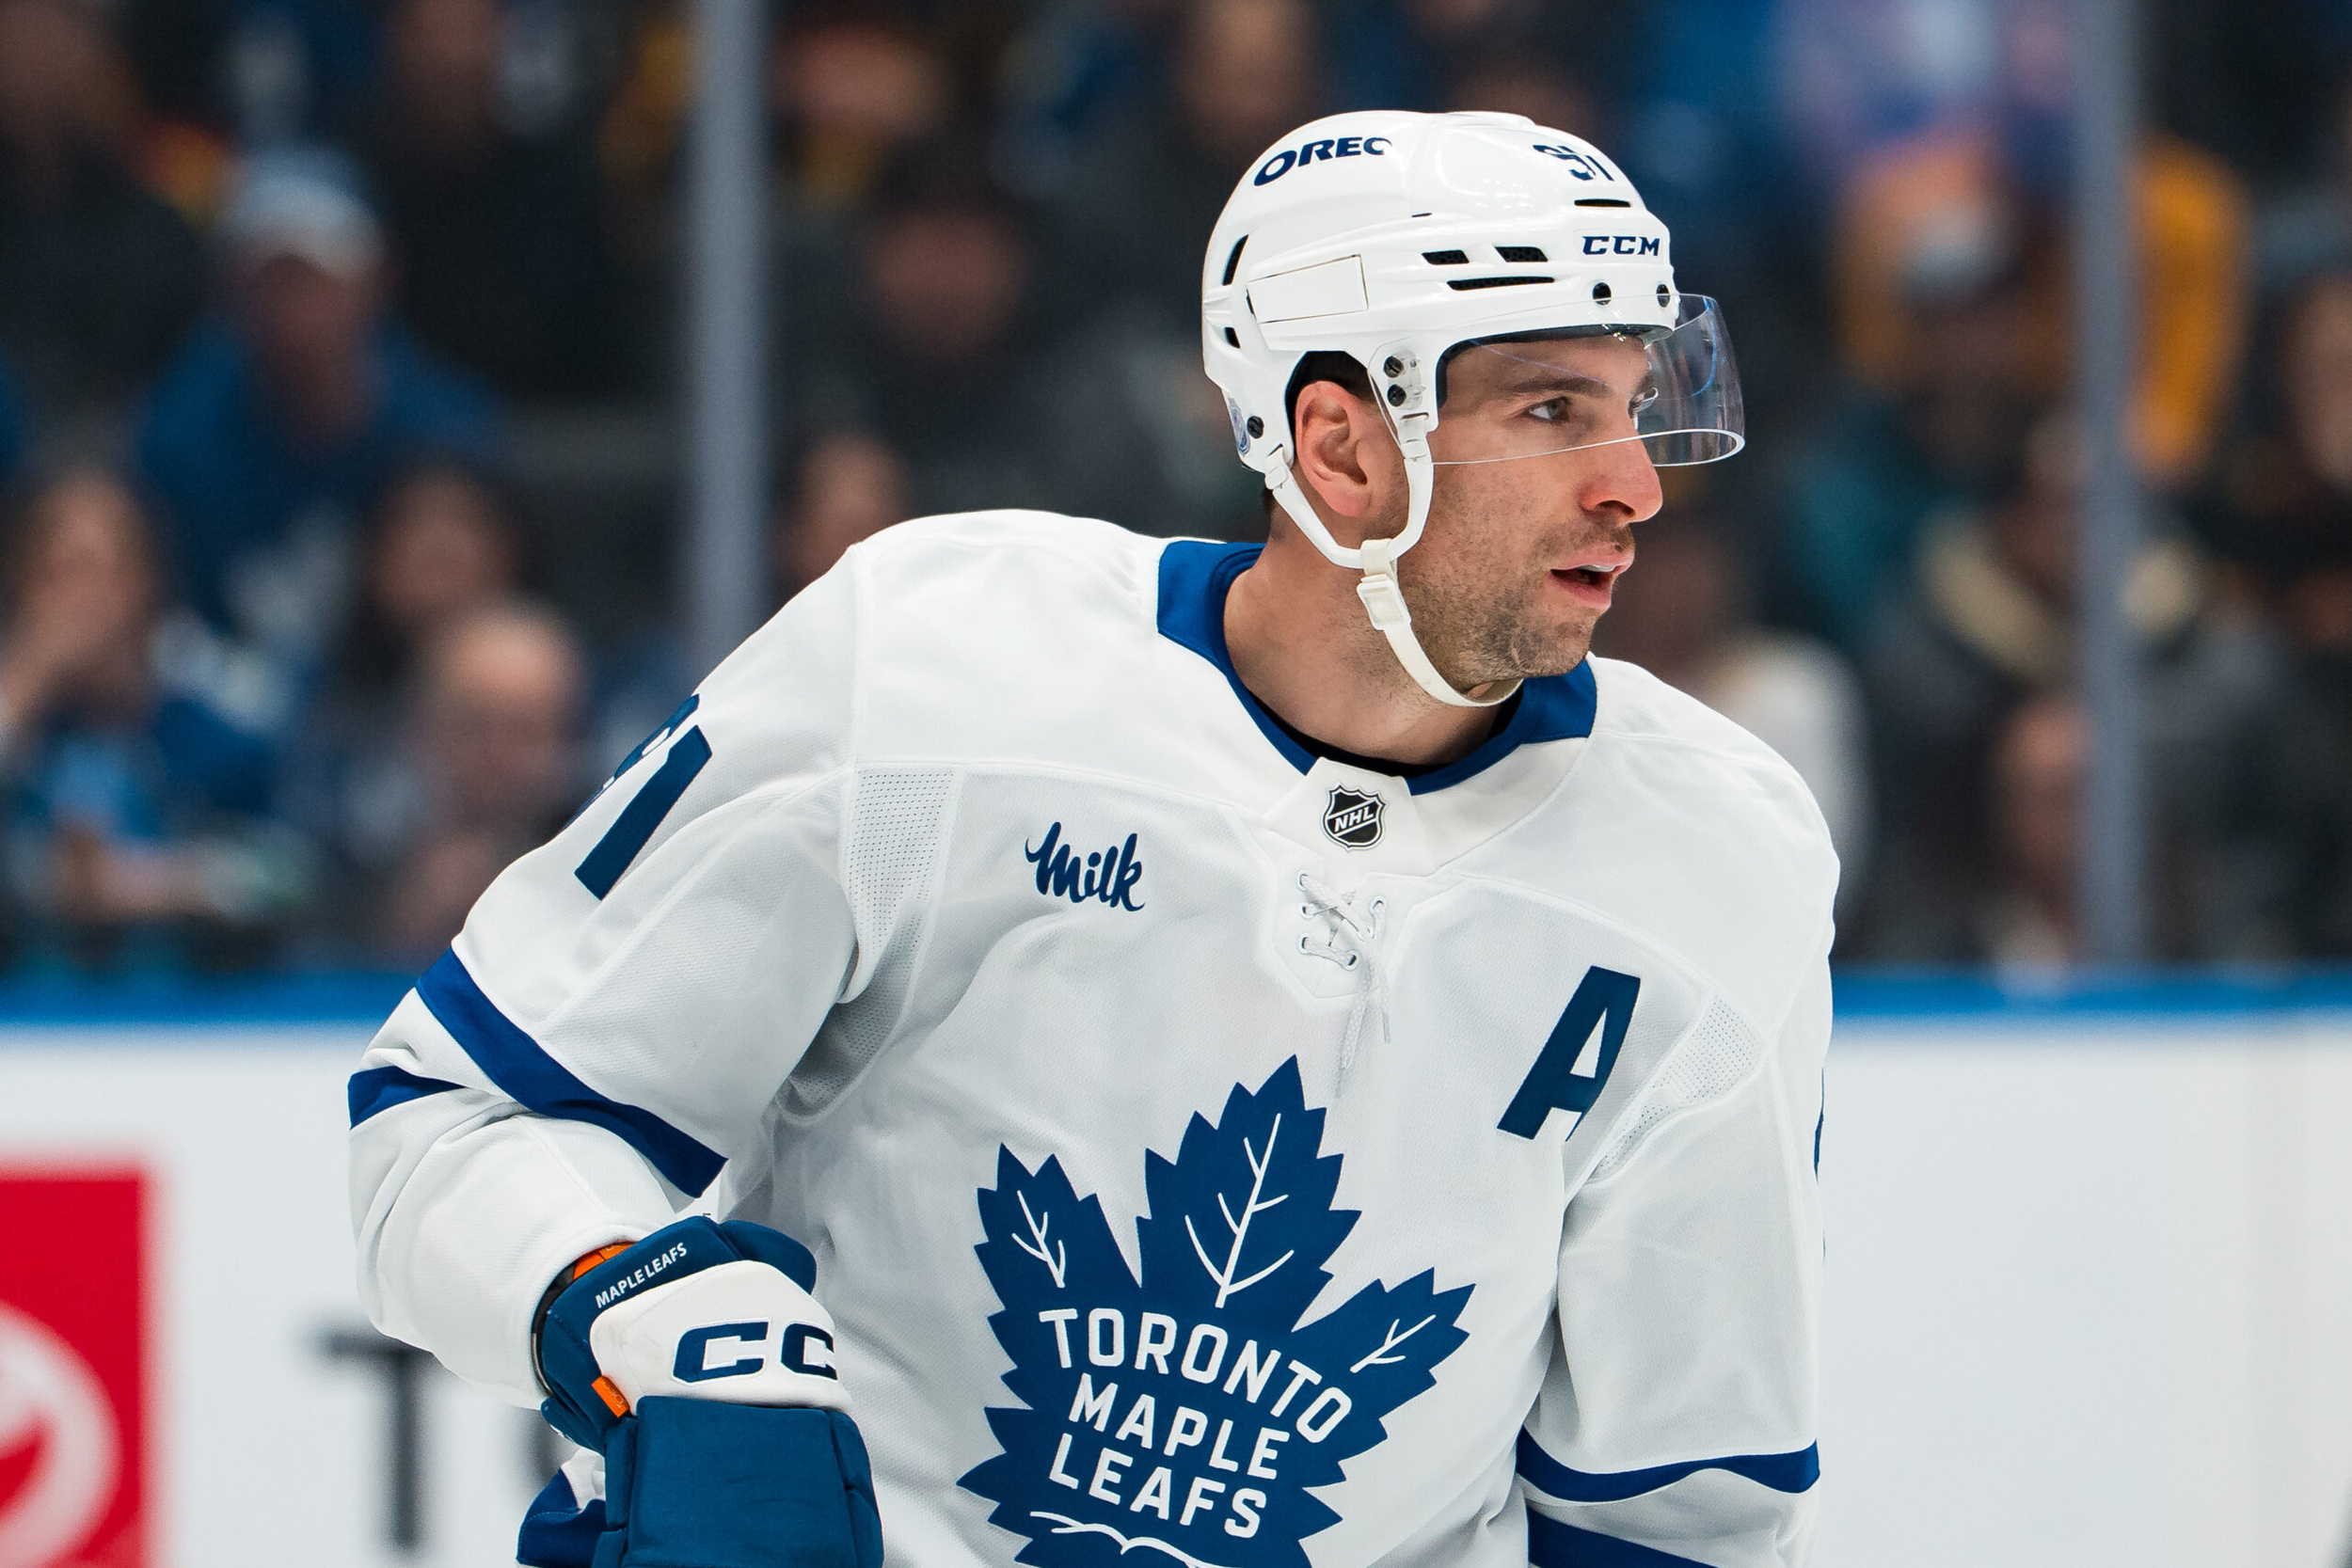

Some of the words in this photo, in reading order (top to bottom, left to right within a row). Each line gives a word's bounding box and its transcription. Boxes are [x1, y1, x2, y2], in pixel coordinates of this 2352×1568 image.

[1582, 235, 1661, 257] CCM
[1025, 821, 1145, 912] Milk
[1334, 805, 1375, 832] NHL
[1497, 965, 1641, 1142] A
[595, 1269, 645, 1308] MAPLE
[644, 1242, 688, 1278] LEAFS
[1039, 1307, 1353, 1444] TORONTO
[1068, 1372, 1291, 1480] MAPLE
[1048, 1433, 1267, 1539] LEAFS
